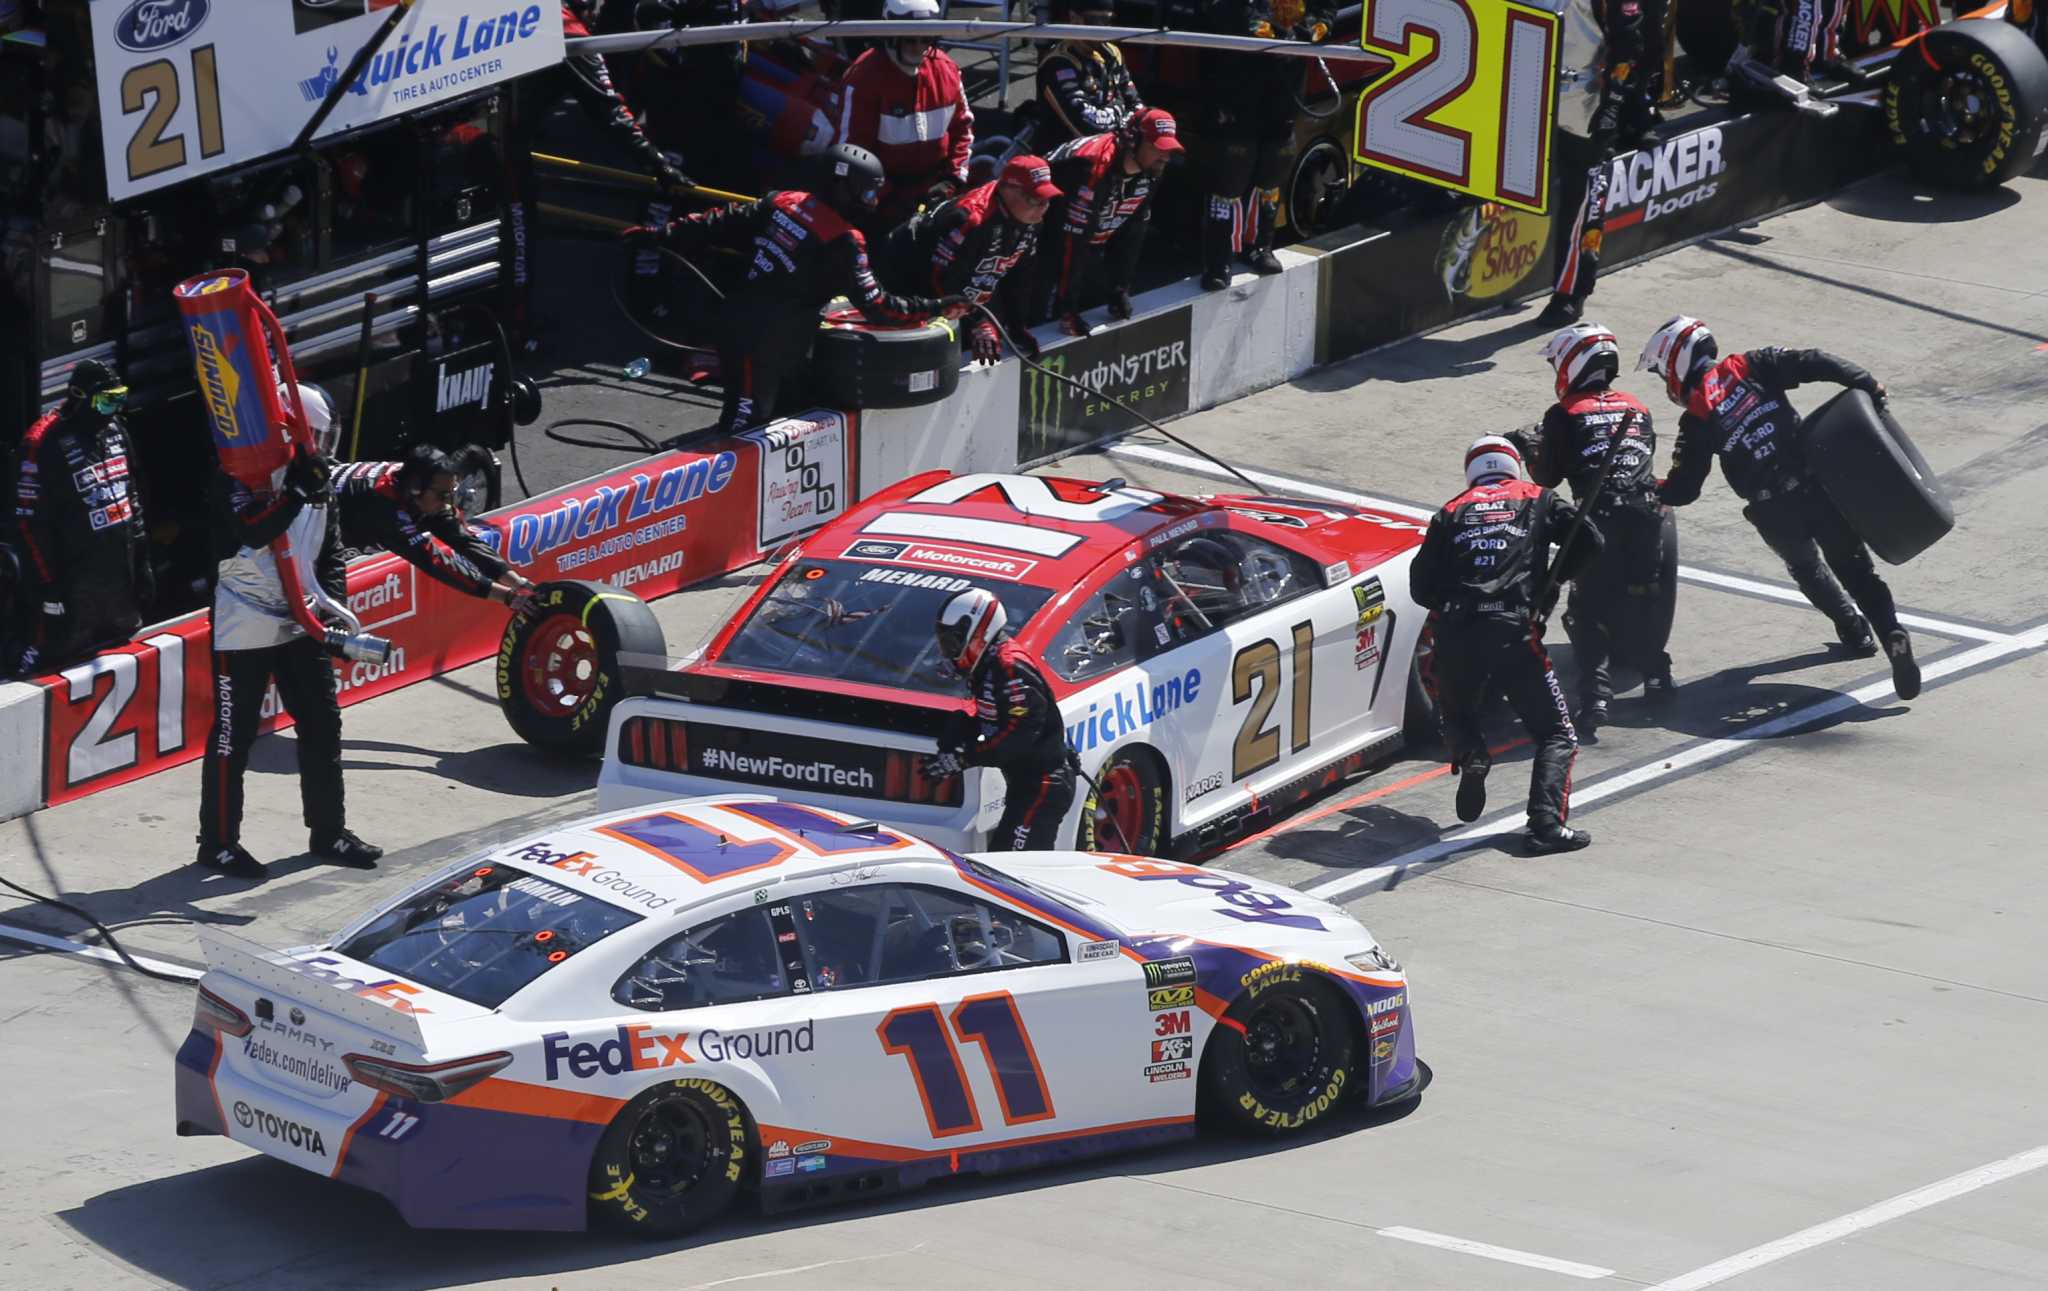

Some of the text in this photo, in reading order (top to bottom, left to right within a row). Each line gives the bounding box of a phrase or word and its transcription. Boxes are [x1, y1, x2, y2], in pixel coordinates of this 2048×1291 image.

[134, 0, 191, 43] Ford
[452, 5, 541, 61] Lane
[393, 58, 503, 103] TIRE & AUTO CENTER
[120, 42, 225, 182] 21
[1358, 0, 1555, 208] 21
[1604, 127, 1724, 213] ACKER
[1643, 180, 1718, 223] boats
[1486, 211, 1518, 248] Pro
[1481, 239, 1538, 282] Shops
[436, 362, 495, 413] KNAUF
[1068, 340, 1188, 401] MONSTER
[1085, 381, 1170, 417] ENERGY
[1714, 385, 1746, 415] MILLS
[1731, 421, 1766, 449] FORD
[507, 450, 738, 568] Quick Lane
[1474, 500, 1506, 511] GRAY
[556, 515, 687, 573] TIRE & AUTO CENTER
[911, 549, 1017, 573] Motorcraft
[1470, 538, 1508, 551] FORD
[1473, 554, 1496, 567] #21
[611, 550, 684, 588] MENARD
[859, 568, 973, 593] MENARD
[348, 573, 402, 611] rcraft
[60, 632, 187, 787] 21
[215, 674, 234, 758] Motorcraft
[1064, 667, 1202, 754] uick Lane
[1231, 617, 1315, 784] 21
[702, 747, 874, 789] #NewFordTech
[505, 841, 679, 911] FedEx Ground
[1249, 971, 1302, 999] EAGLE
[1366, 993, 1403, 1017] MOOG
[258, 1019, 335, 1052] CAMRY
[1154, 1010, 1191, 1036] 3M
[541, 1018, 815, 1082] FedEx Ground
[875, 988, 1057, 1140] 11
[1145, 1062, 1184, 1076] LINCOLN
[1239, 1068, 1346, 1128] GOODYEAR
[254, 1108, 328, 1158] TOYOTA
[379, 1111, 419, 1140] 11
[674, 1078, 745, 1182] GOODYEAR
